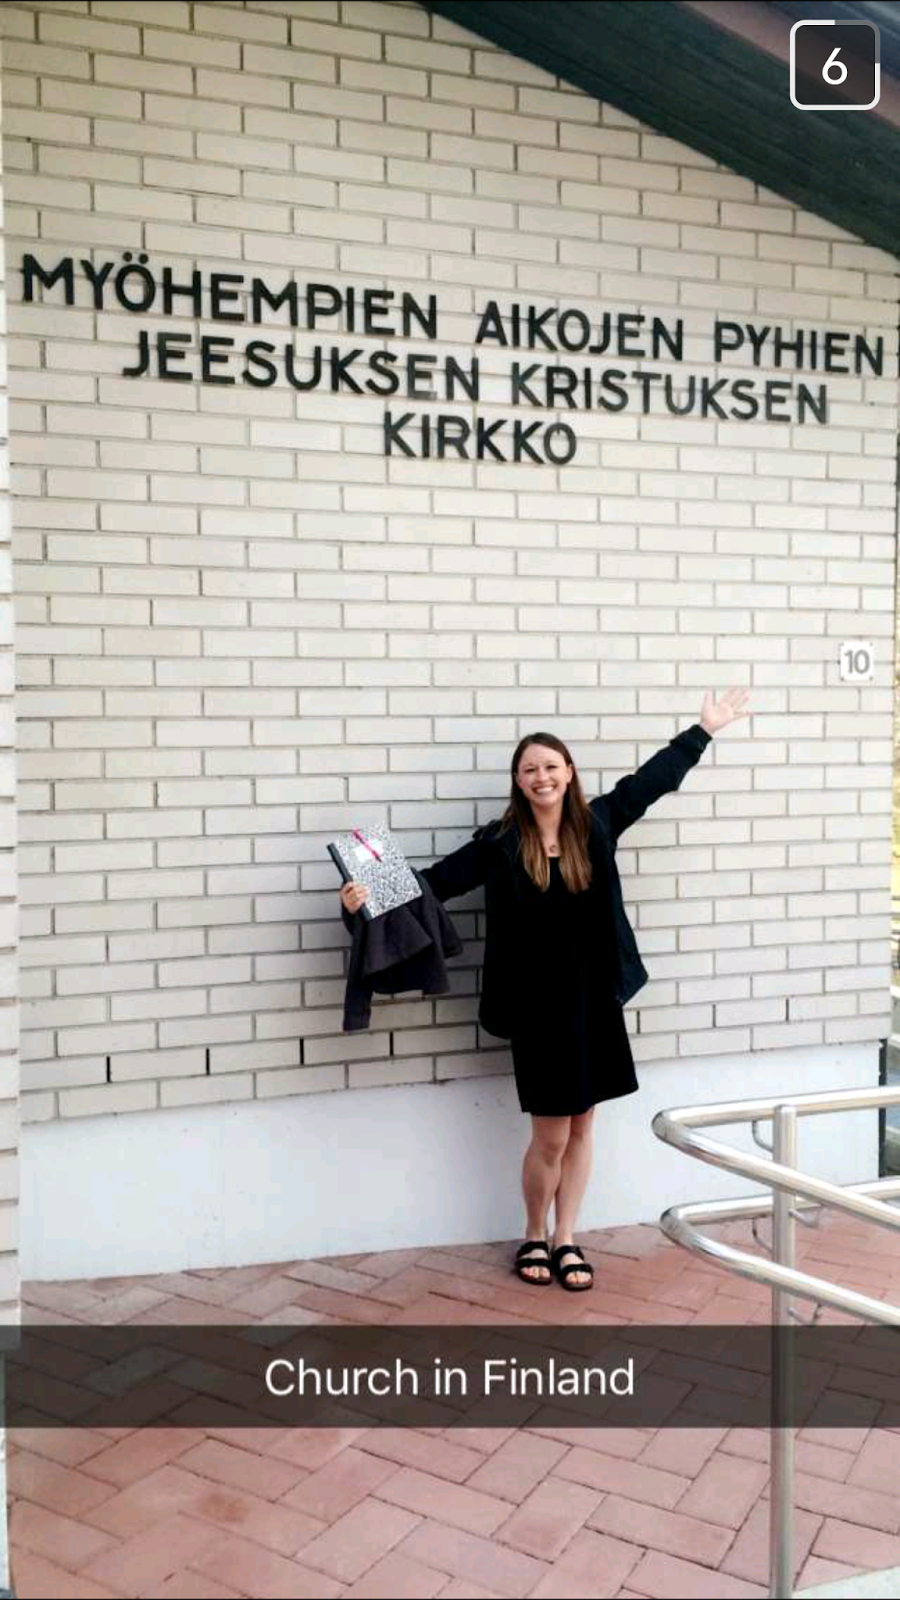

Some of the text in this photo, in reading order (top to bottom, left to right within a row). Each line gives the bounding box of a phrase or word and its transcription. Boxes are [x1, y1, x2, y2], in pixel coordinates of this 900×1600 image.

[20, 251, 885, 377] MYÖHEMPIEN AIKOJEN PYHIEN
[121, 330, 828, 424] JEESUKSEN KRISTUKSEN
[382, 411, 578, 467] KIRKKO
[843, 649, 871, 675] 10
